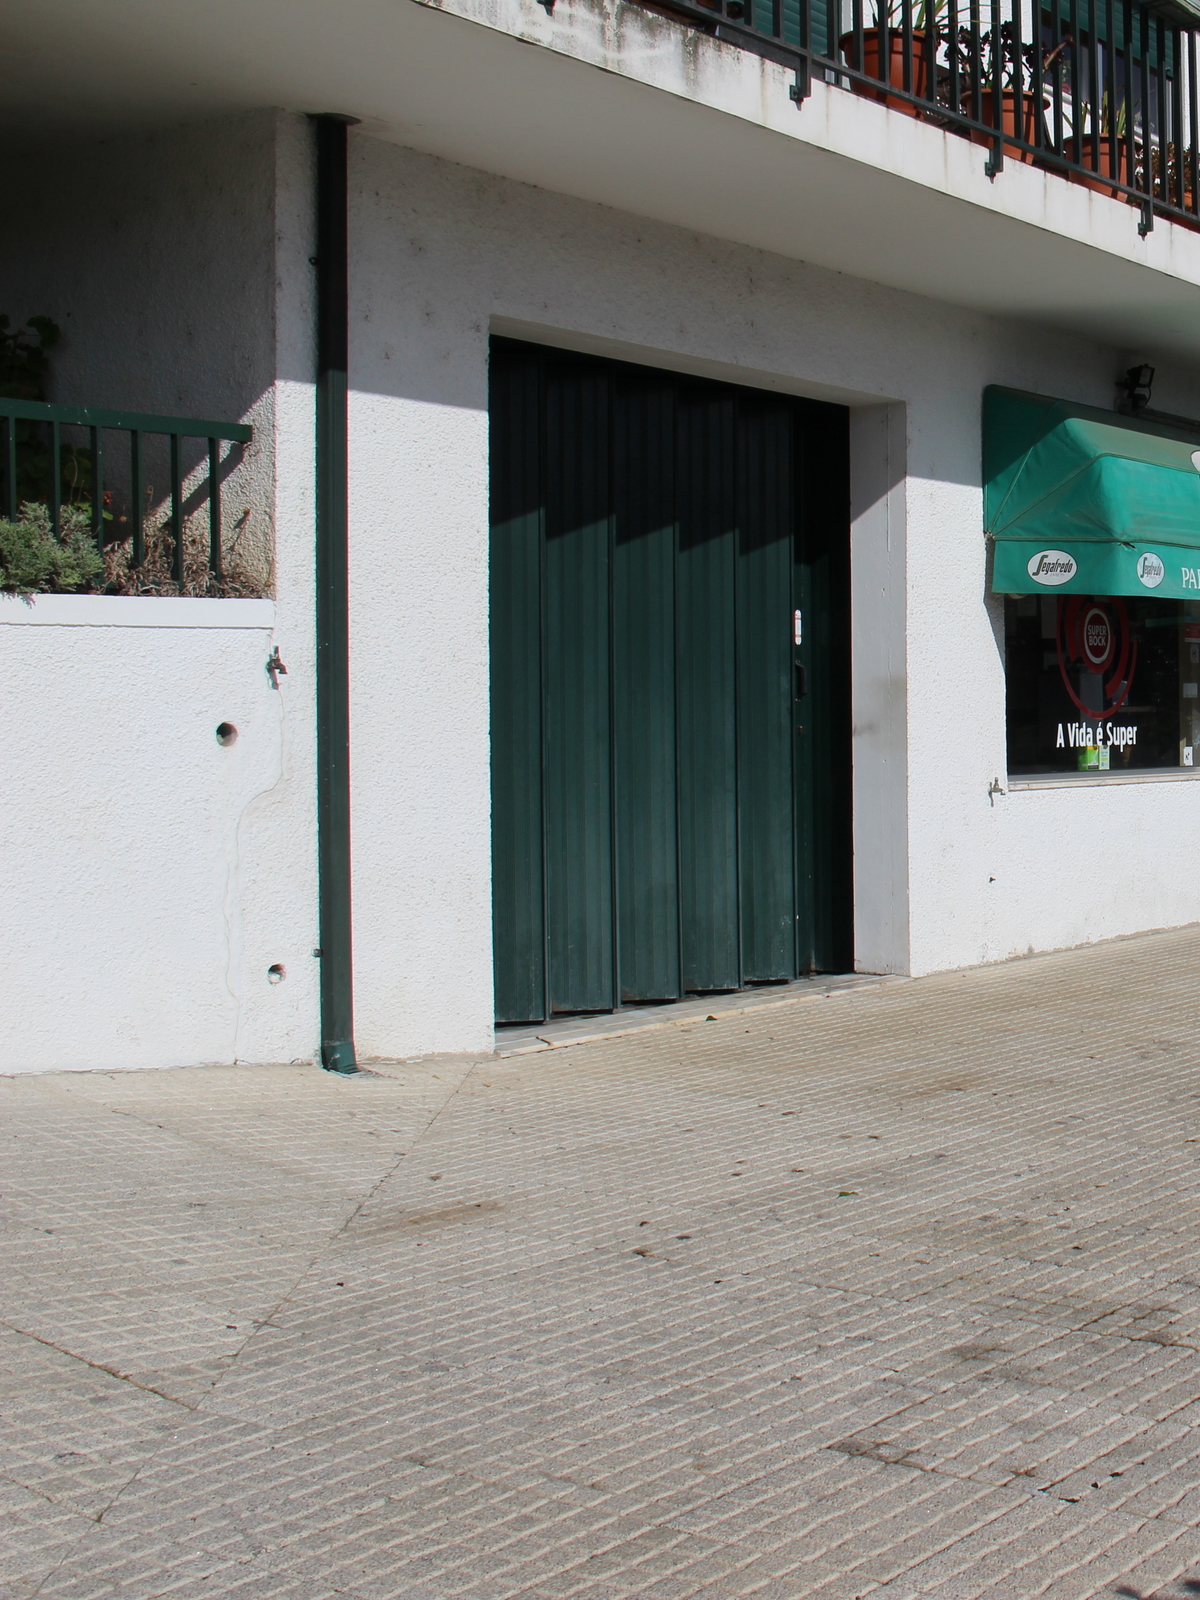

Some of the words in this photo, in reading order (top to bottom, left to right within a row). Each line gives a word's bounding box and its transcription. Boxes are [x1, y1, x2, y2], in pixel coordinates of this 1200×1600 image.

[1032, 555, 1073, 575] Segafredo
[1088, 624, 1106, 635] SUPER
[1089, 635, 1106, 646] BOCK
[1056, 723, 1065, 748] A
[1067, 722, 1093, 748] Vida
[1096, 722, 1104, 746] é
[1106, 722, 1138, 753] Super
